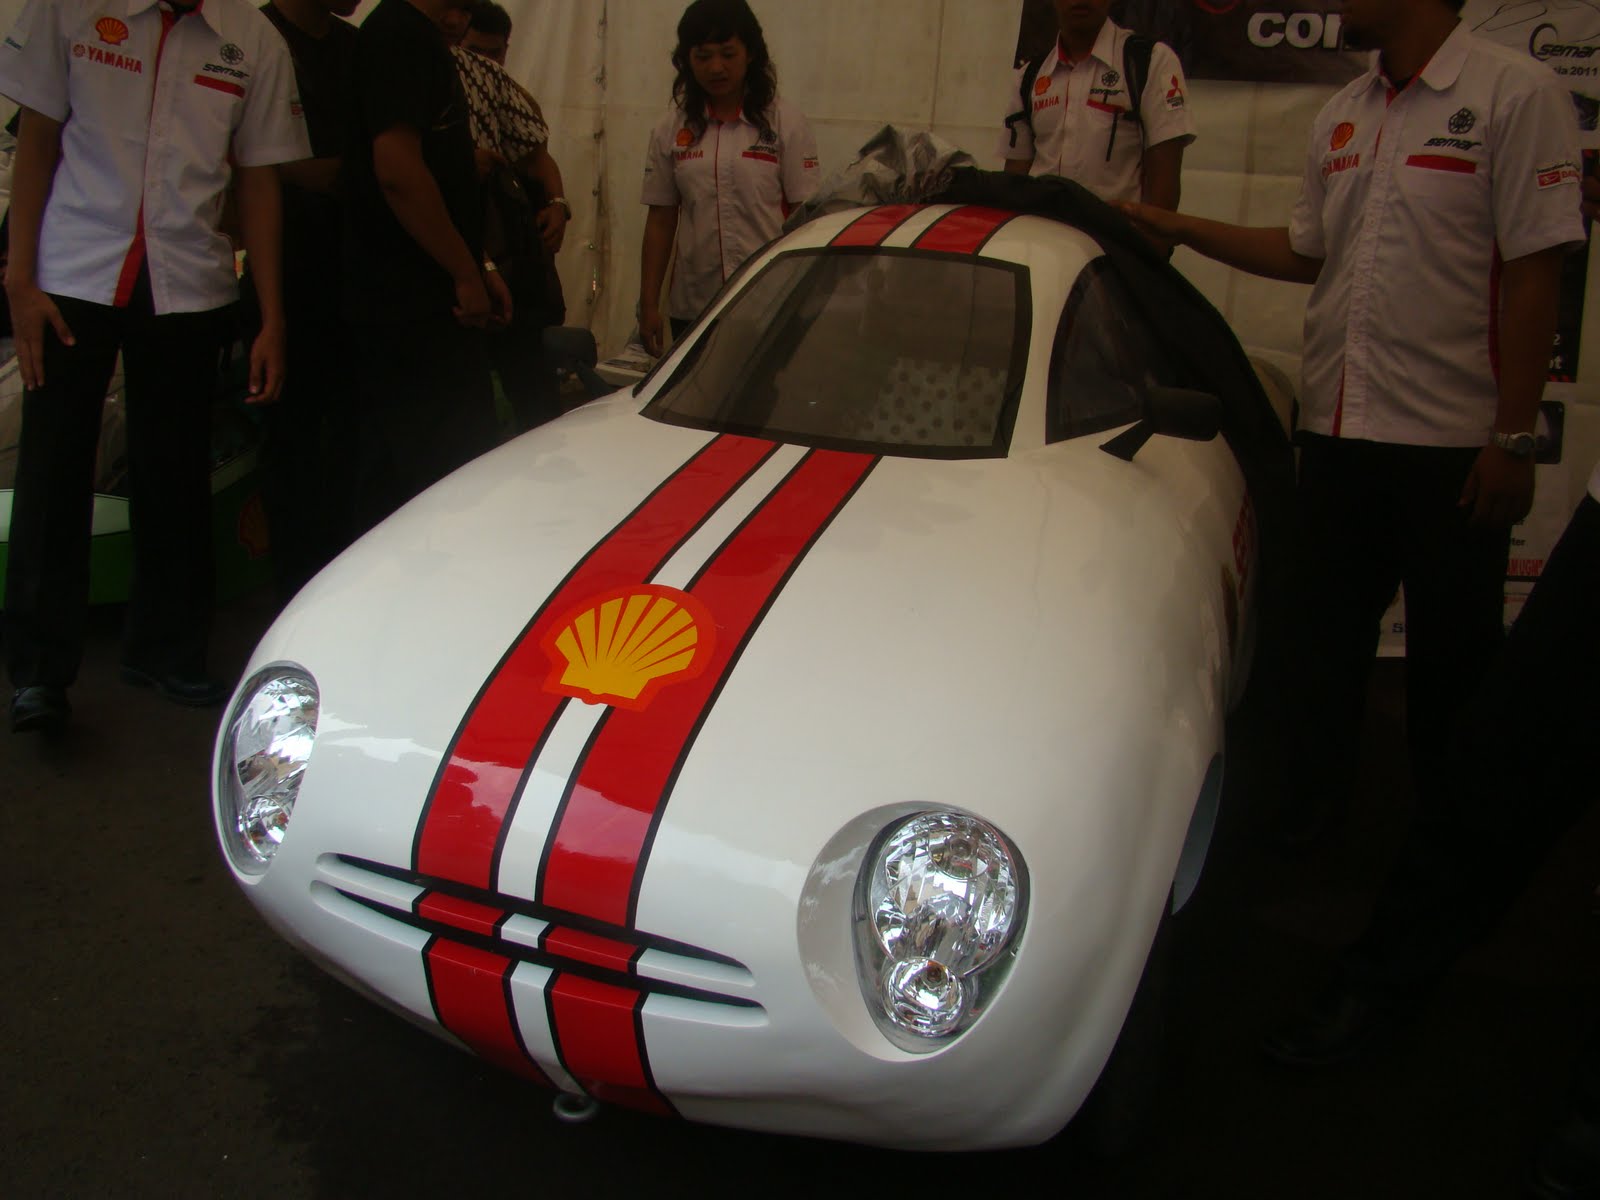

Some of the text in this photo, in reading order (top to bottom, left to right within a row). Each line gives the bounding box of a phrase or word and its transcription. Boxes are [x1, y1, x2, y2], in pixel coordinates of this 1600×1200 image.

[88, 46, 143, 74] YAMAHA
[203, 63, 250, 79] semar
[1570, 66, 1598, 76] 2011
[1424, 138, 1482, 150] semar
[1511, 538, 1526, 546] ter
